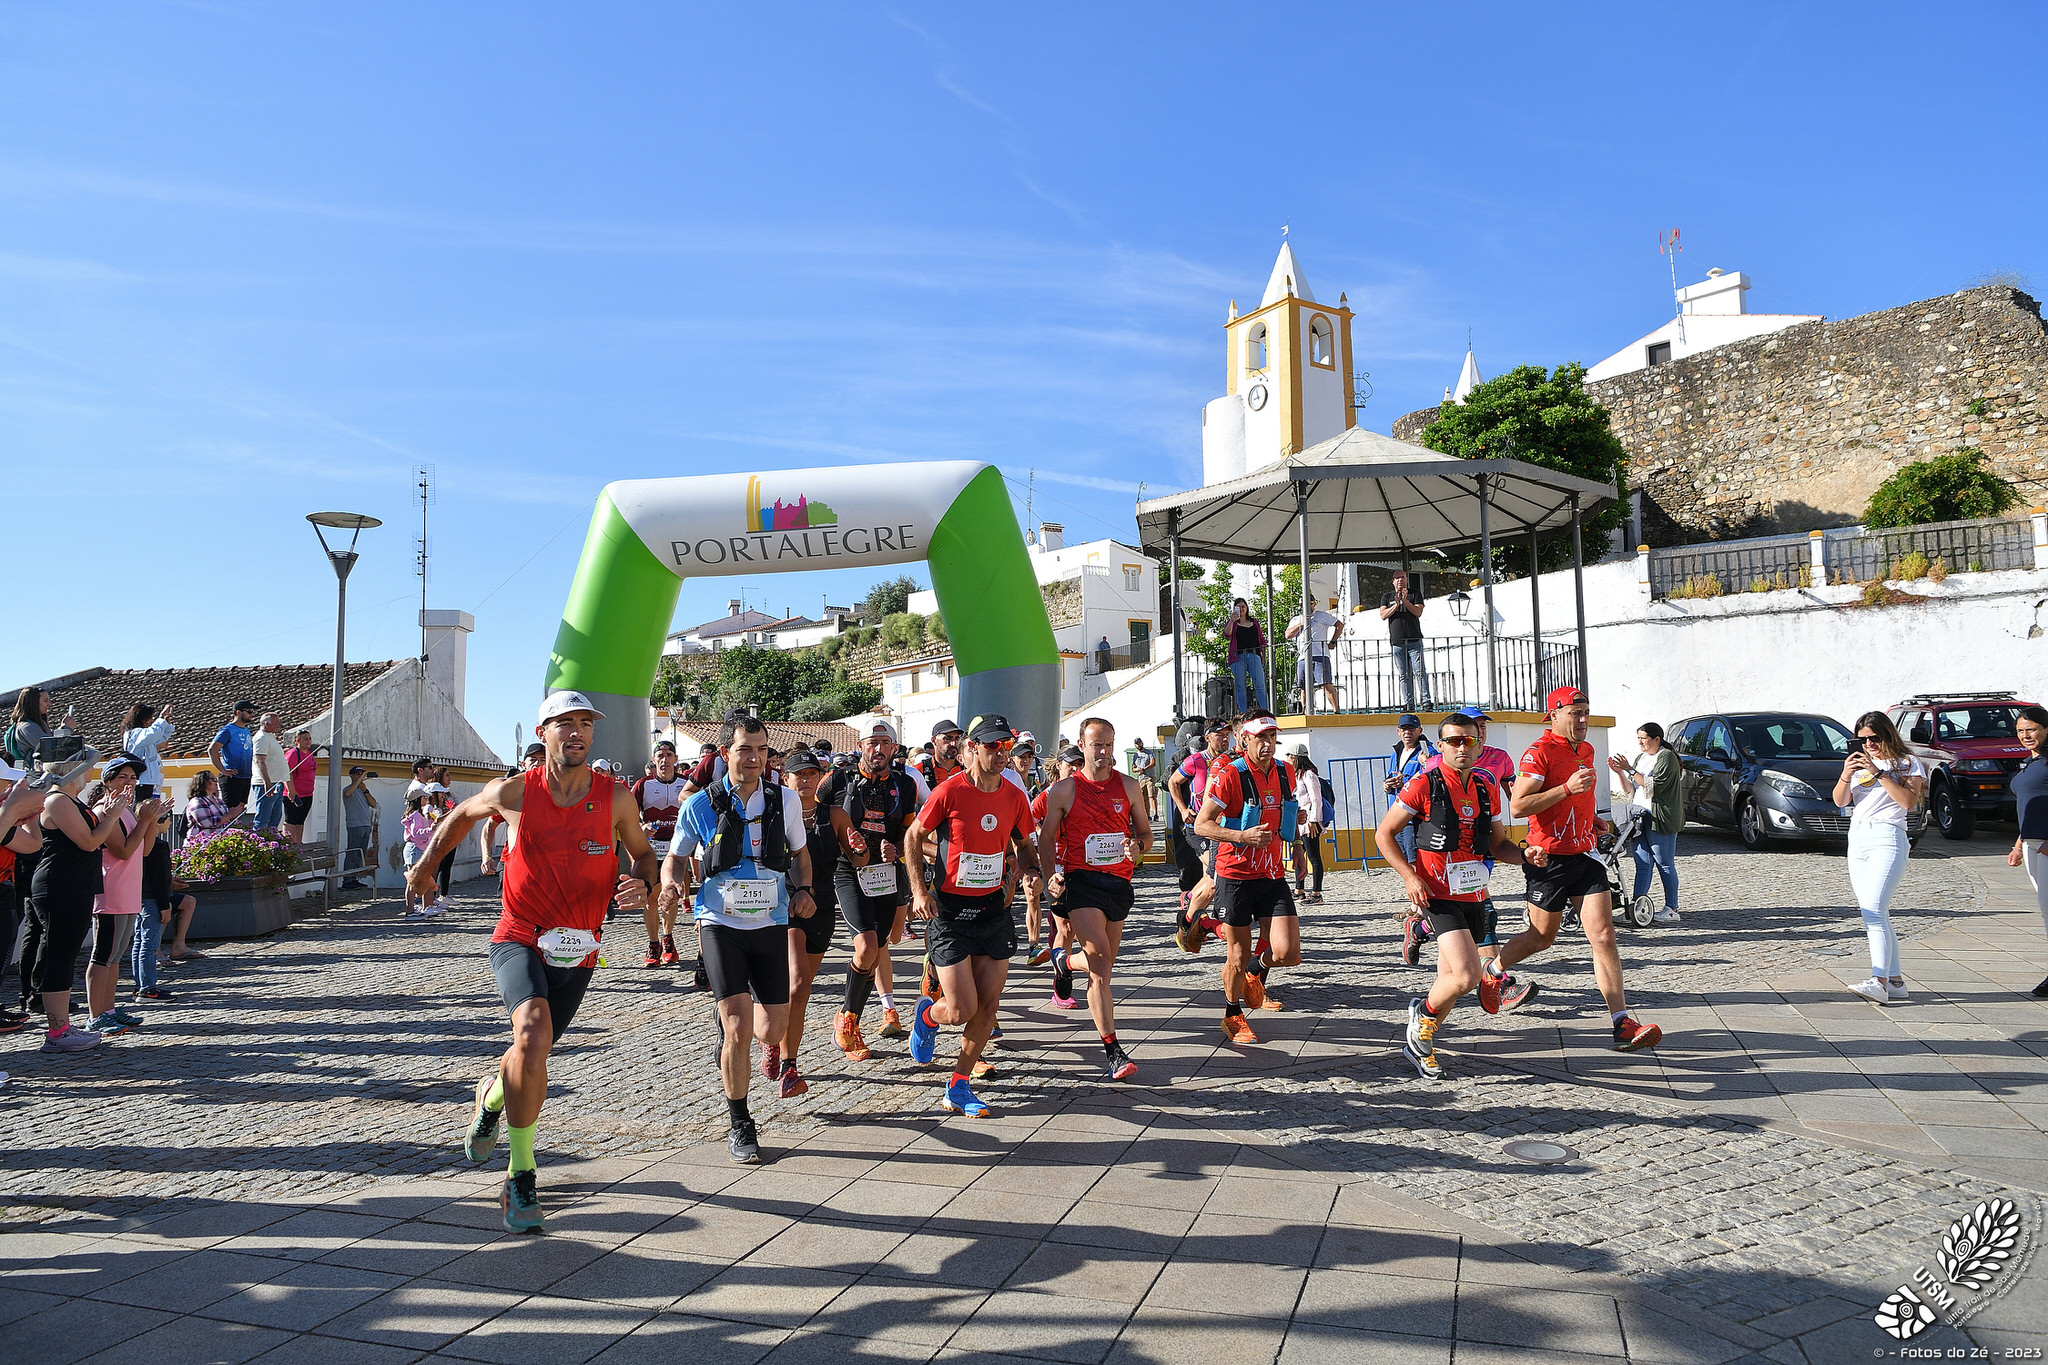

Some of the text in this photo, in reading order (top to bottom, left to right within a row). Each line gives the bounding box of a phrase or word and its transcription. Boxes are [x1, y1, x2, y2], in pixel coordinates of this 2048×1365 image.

[670, 524, 918, 566] PORTALEGRE
[975, 863, 993, 871] 2189
[872, 872, 887, 880] 2101
[1462, 870, 1477, 878] 2159
[743, 890, 762, 898] 2151
[560, 936, 582, 946] 2239
